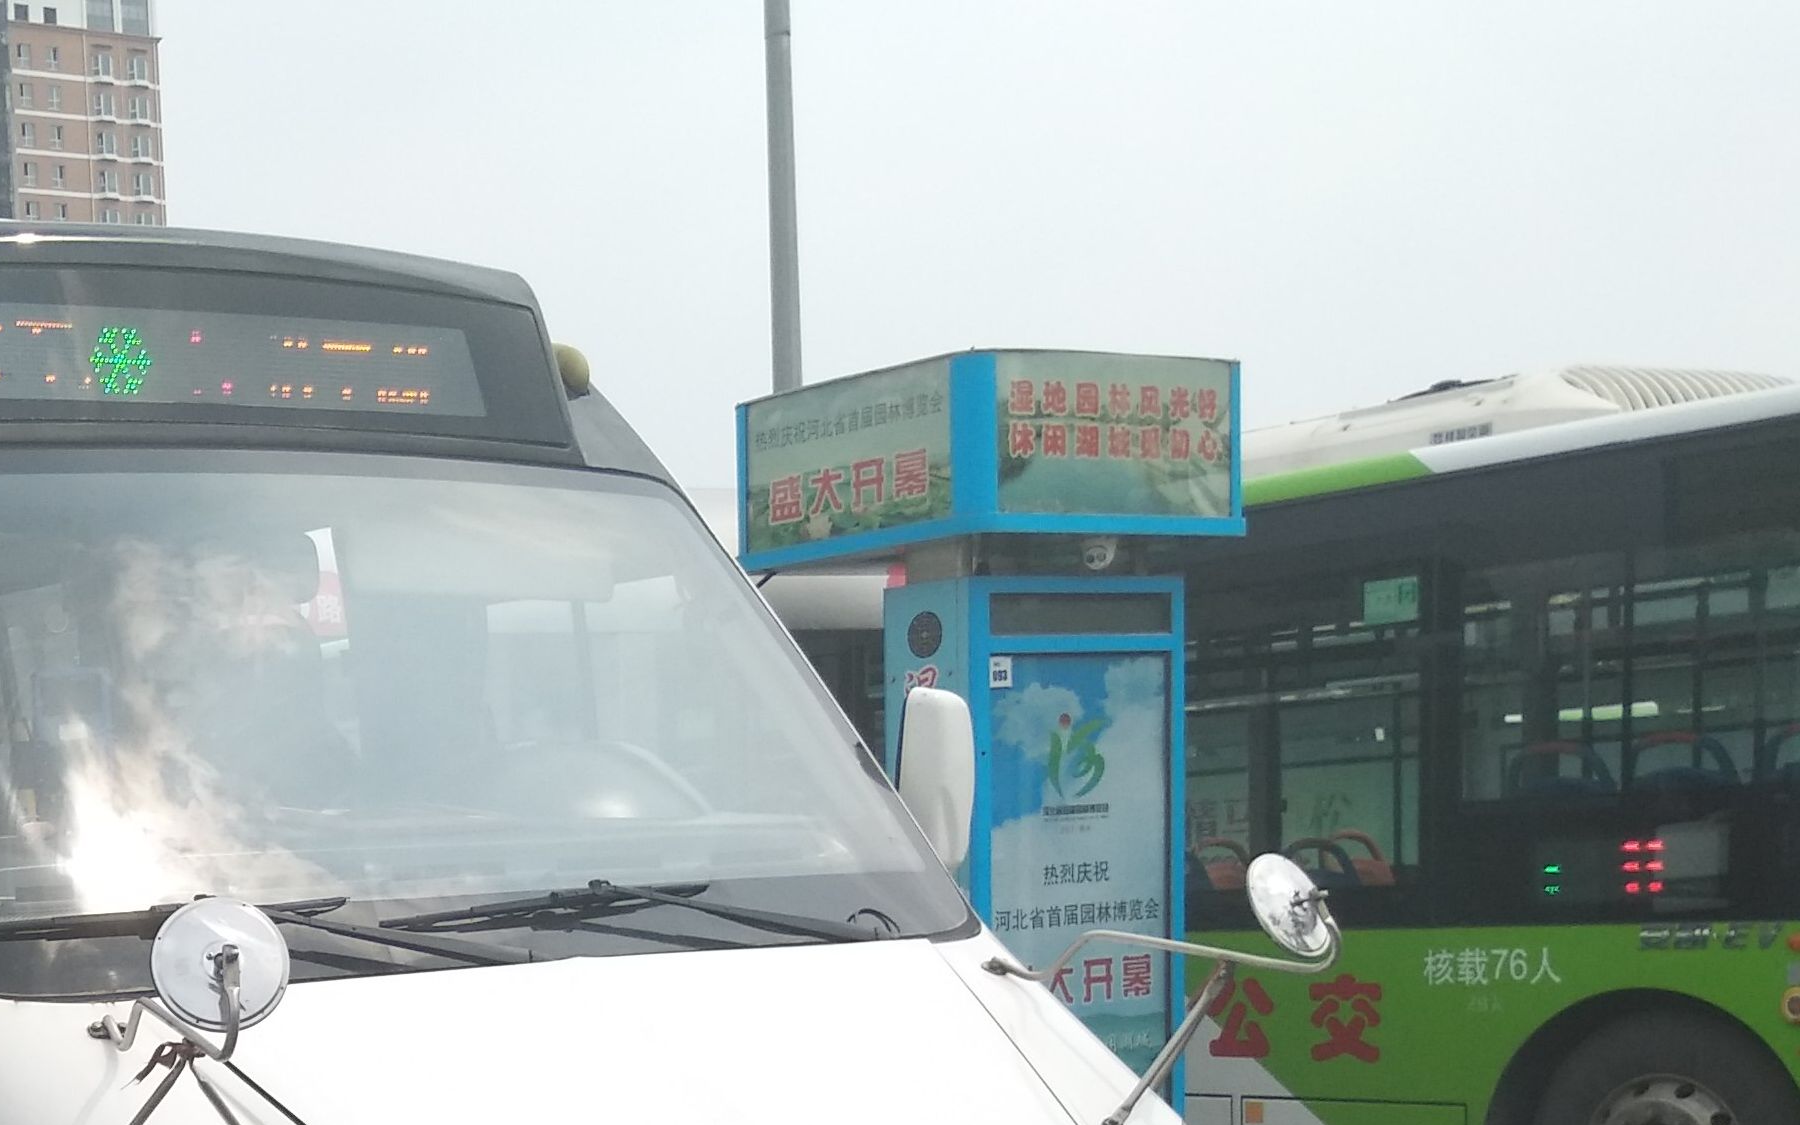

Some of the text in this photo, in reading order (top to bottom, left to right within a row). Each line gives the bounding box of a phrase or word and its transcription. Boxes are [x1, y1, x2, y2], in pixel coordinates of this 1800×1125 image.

[770, 448, 928, 524] 盛大开幕
[1043, 861, 1110, 885] 热烈庆祝
[995, 898, 1160, 932] 河北省首届园林博览会
[1423, 947, 1562, 986] 核载76人
[1187, 973, 1383, 1063] 公交
